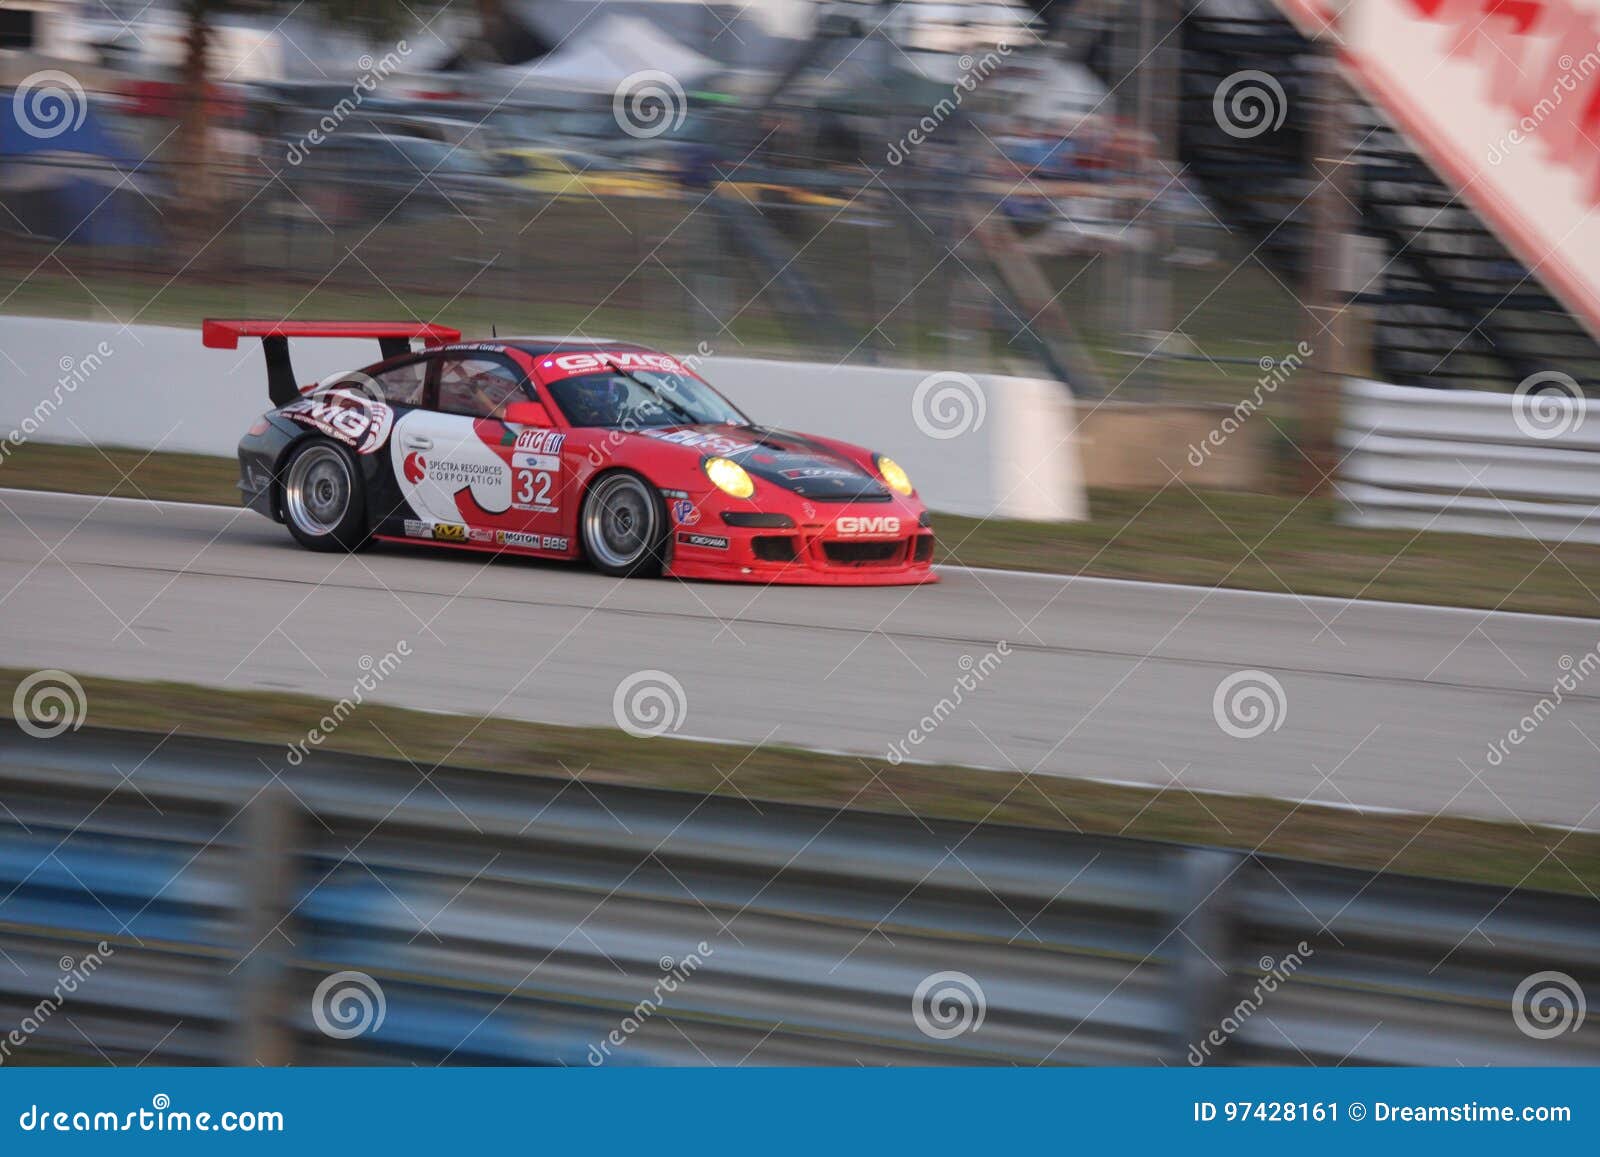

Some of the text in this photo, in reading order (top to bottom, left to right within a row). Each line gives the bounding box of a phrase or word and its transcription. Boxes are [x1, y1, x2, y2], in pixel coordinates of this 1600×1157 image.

[518, 429, 545, 450] GTC
[429, 460, 503, 476] SPECTRA RESOURCES
[429, 471, 502, 486] CORPORATION
[517, 469, 553, 506] 32
[836, 516, 900, 533] GMG
[505, 532, 540, 545] MOTON
[542, 536, 569, 551] BBS
